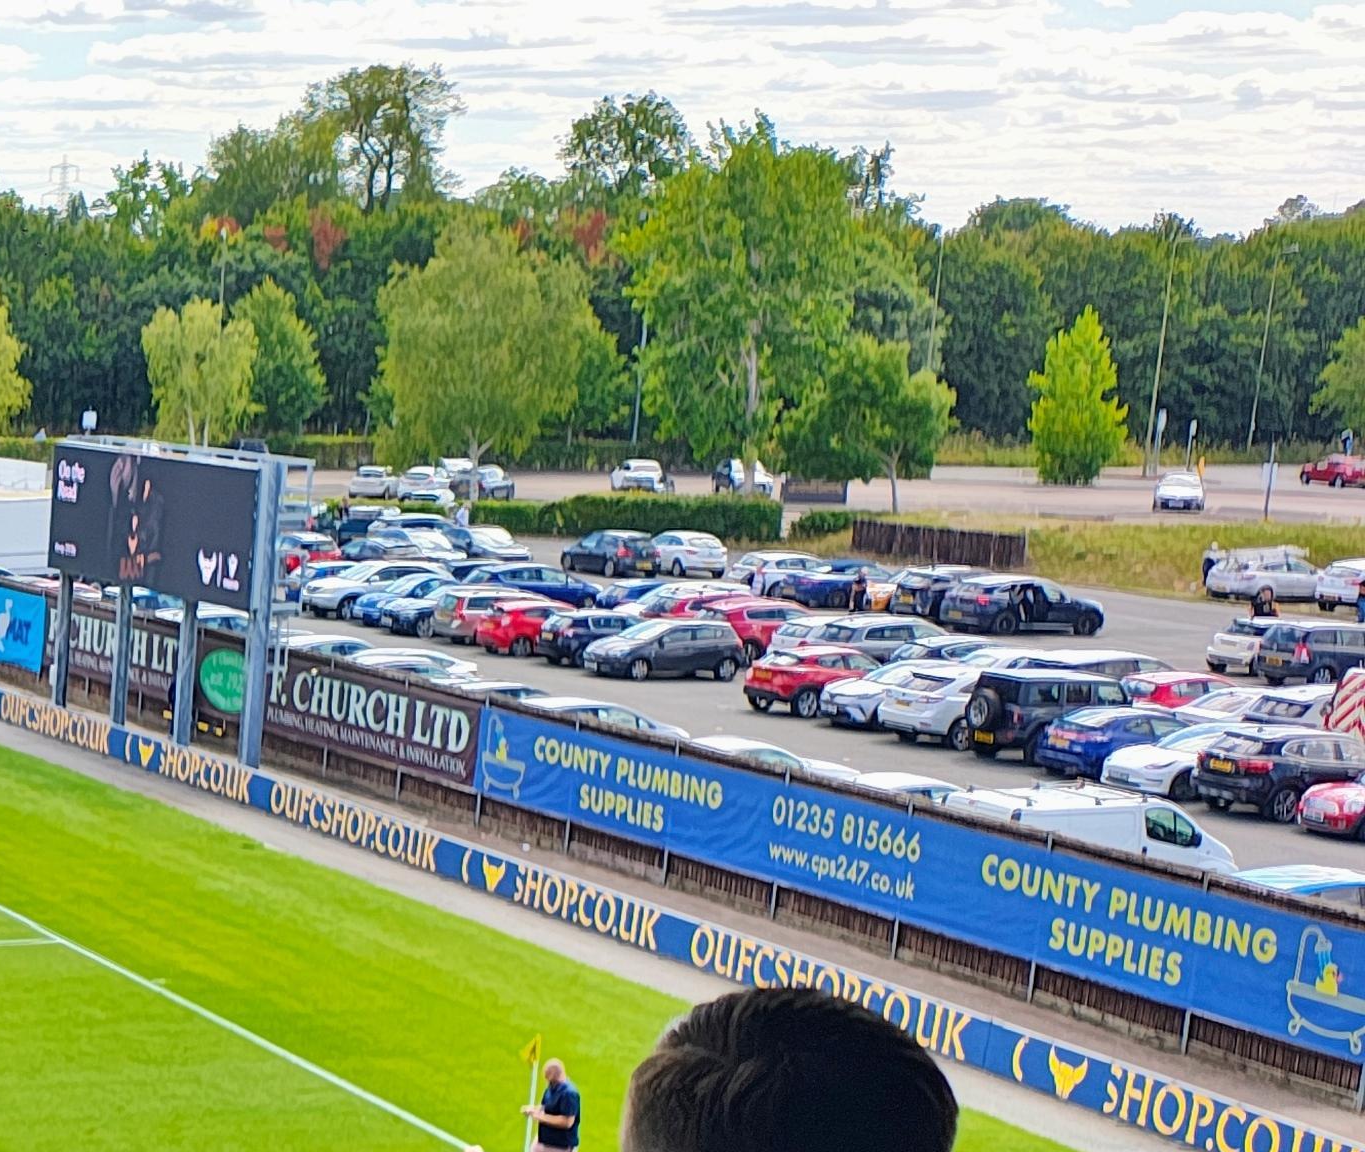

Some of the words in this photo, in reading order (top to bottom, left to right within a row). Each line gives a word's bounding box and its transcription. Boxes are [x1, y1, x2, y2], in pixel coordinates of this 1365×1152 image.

[69, 612, 148, 667] CHURH
[151, 633, 178, 675] LT
[0, 693, 111, 755] OUFCSHOP.CO.UK
[292, 671, 408, 739] CHURCH
[411, 700, 471, 754] LTD
[533, 735, 612, 780] COUNTY
[616, 756, 724, 810] PLUMBING
[270, 781, 441, 873] OUFCSHOP.CO.UK
[579, 783, 665, 833] SUPPLIES
[772, 795, 836, 840] 01235
[841, 813, 921, 863] 815666
[768, 841, 916, 901] www.cps247.co.uk
[981, 853, 1103, 914] COUNTY
[1108, 887, 1278, 964] PLUMBING
[1048, 918, 1183, 988] SUPPLIES
